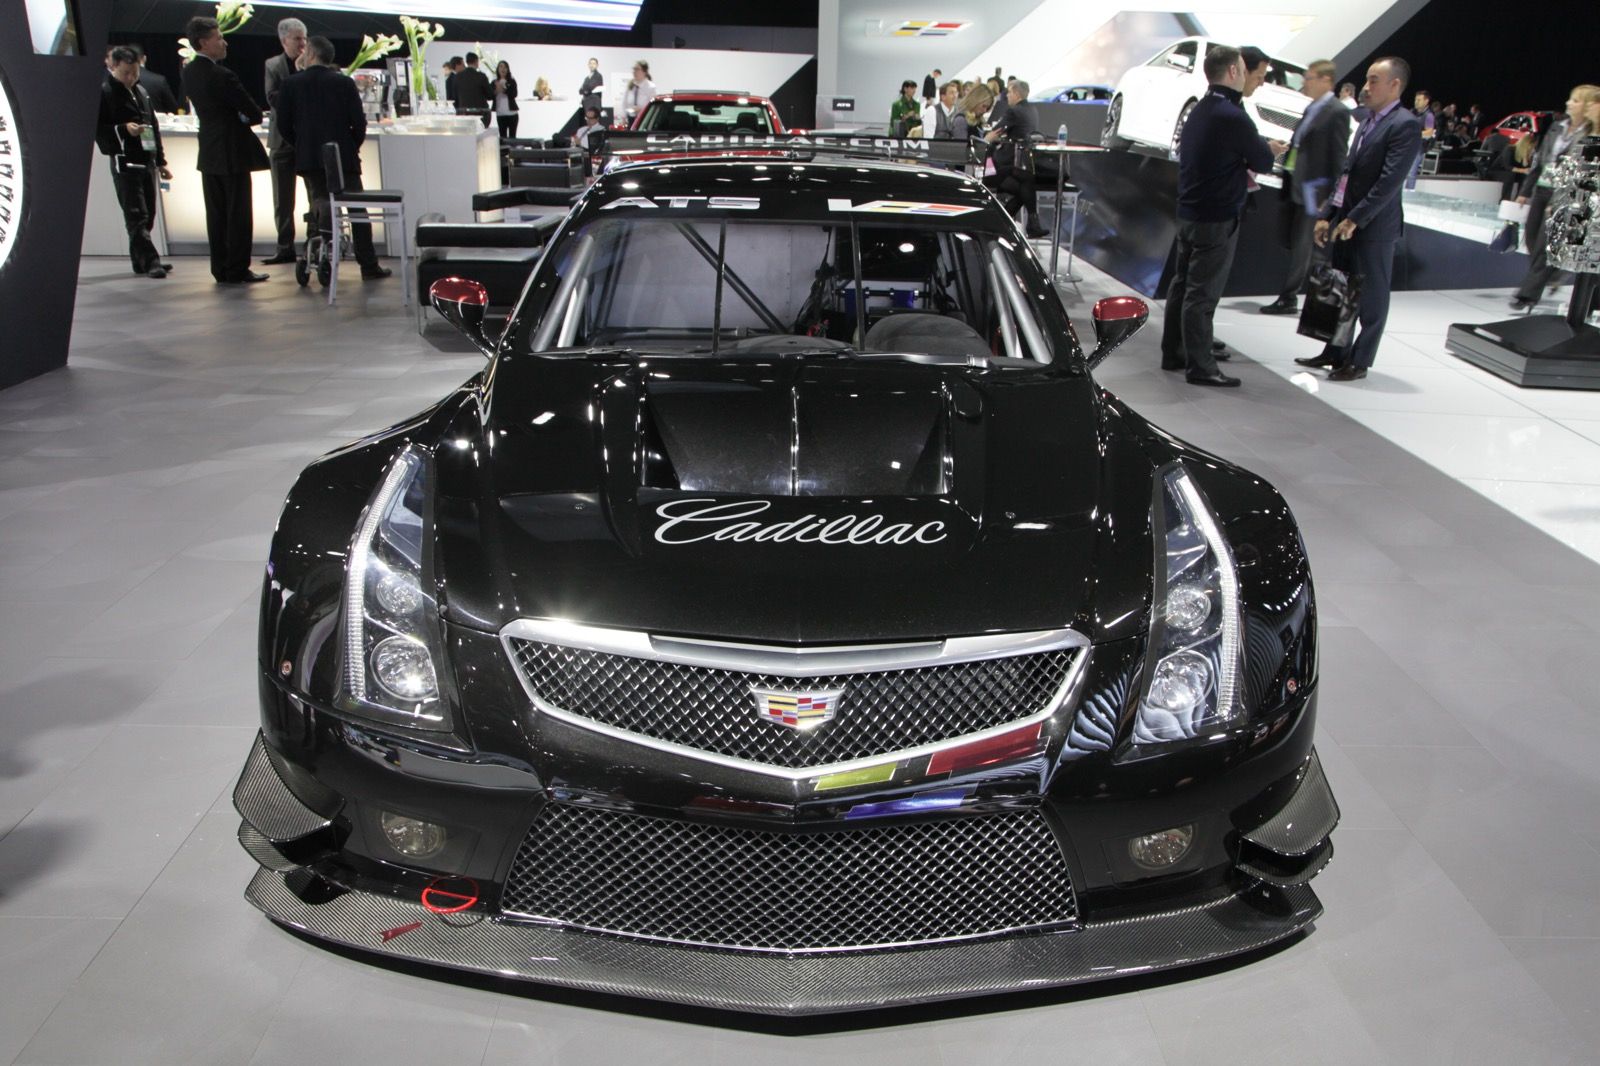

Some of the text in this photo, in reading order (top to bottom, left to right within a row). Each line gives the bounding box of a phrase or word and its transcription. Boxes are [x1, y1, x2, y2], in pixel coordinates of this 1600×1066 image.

[646, 133, 930, 150] CADILLAC.COM
[600, 196, 761, 210] ATS
[654, 498, 948, 545] Cadillac
